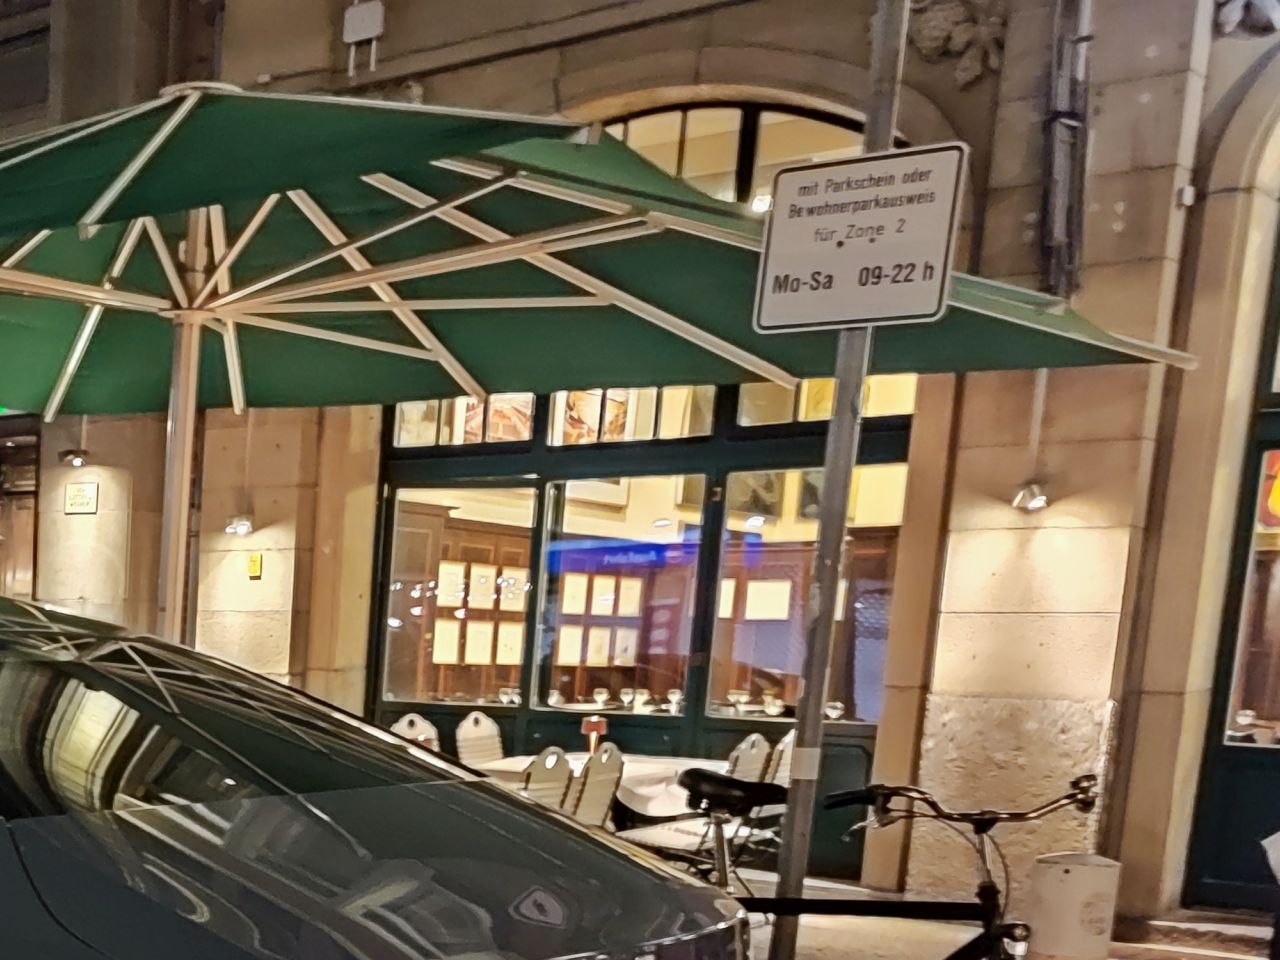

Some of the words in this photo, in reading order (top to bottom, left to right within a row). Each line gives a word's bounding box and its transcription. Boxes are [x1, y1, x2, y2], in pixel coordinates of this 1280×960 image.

[798, 181, 819, 197] mit
[824, 172, 896, 194] Parkschein
[901, 167, 933, 184] oder
[814, 225, 836, 242] für
[845, 221, 885, 240] Zone
[896, 218, 907, 233] 2
[772, 271, 834, 294] Mo-Sa
[858, 262, 916, 287] 09-22
